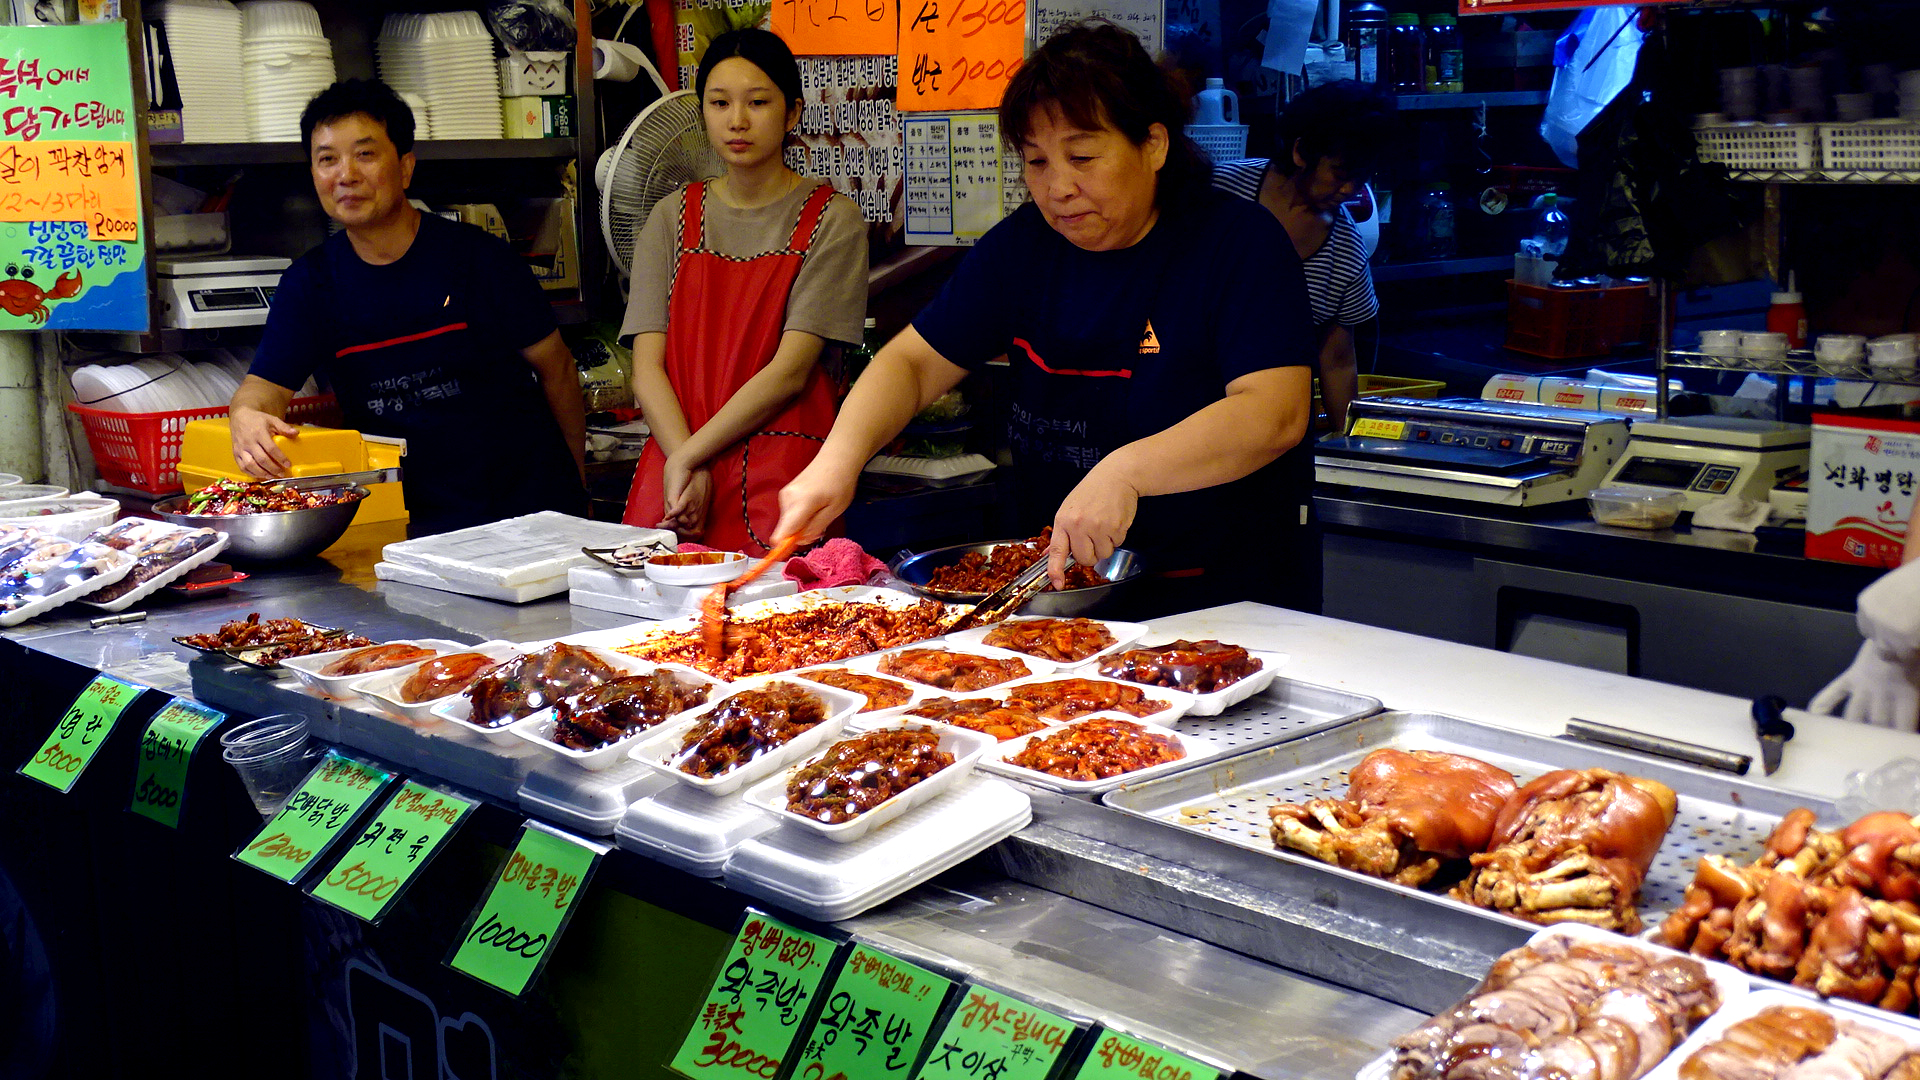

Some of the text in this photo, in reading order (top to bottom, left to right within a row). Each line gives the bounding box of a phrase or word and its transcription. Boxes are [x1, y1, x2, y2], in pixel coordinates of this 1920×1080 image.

[814, 59, 833, 88] 성분과
[836, 58, 856, 87] 젤라틴
[860, 58, 882, 88] 성분이
[913, 53, 942, 95] 반근
[836, 101, 857, 133] 어린이
[859, 100, 874, 132] 성장
[811, 147, 830, 176] 고혈압
[834, 147, 841, 176] 등
[844, 146, 865, 176] 성인병
[94, 212, 137, 237] 20000
[22, 242, 95, 270] 깔끔한
[35, 742, 82, 773] 5000
[136, 772, 179, 808] 5000
[326, 861, 399, 901] 5000
[502, 851, 577, 909] 매운족발
[467, 912, 548, 958] 10000
[718, 957, 807, 1026] 왕족발
[820, 991, 913, 1071] 왕족발
[693, 1031, 781, 1079] 30000
